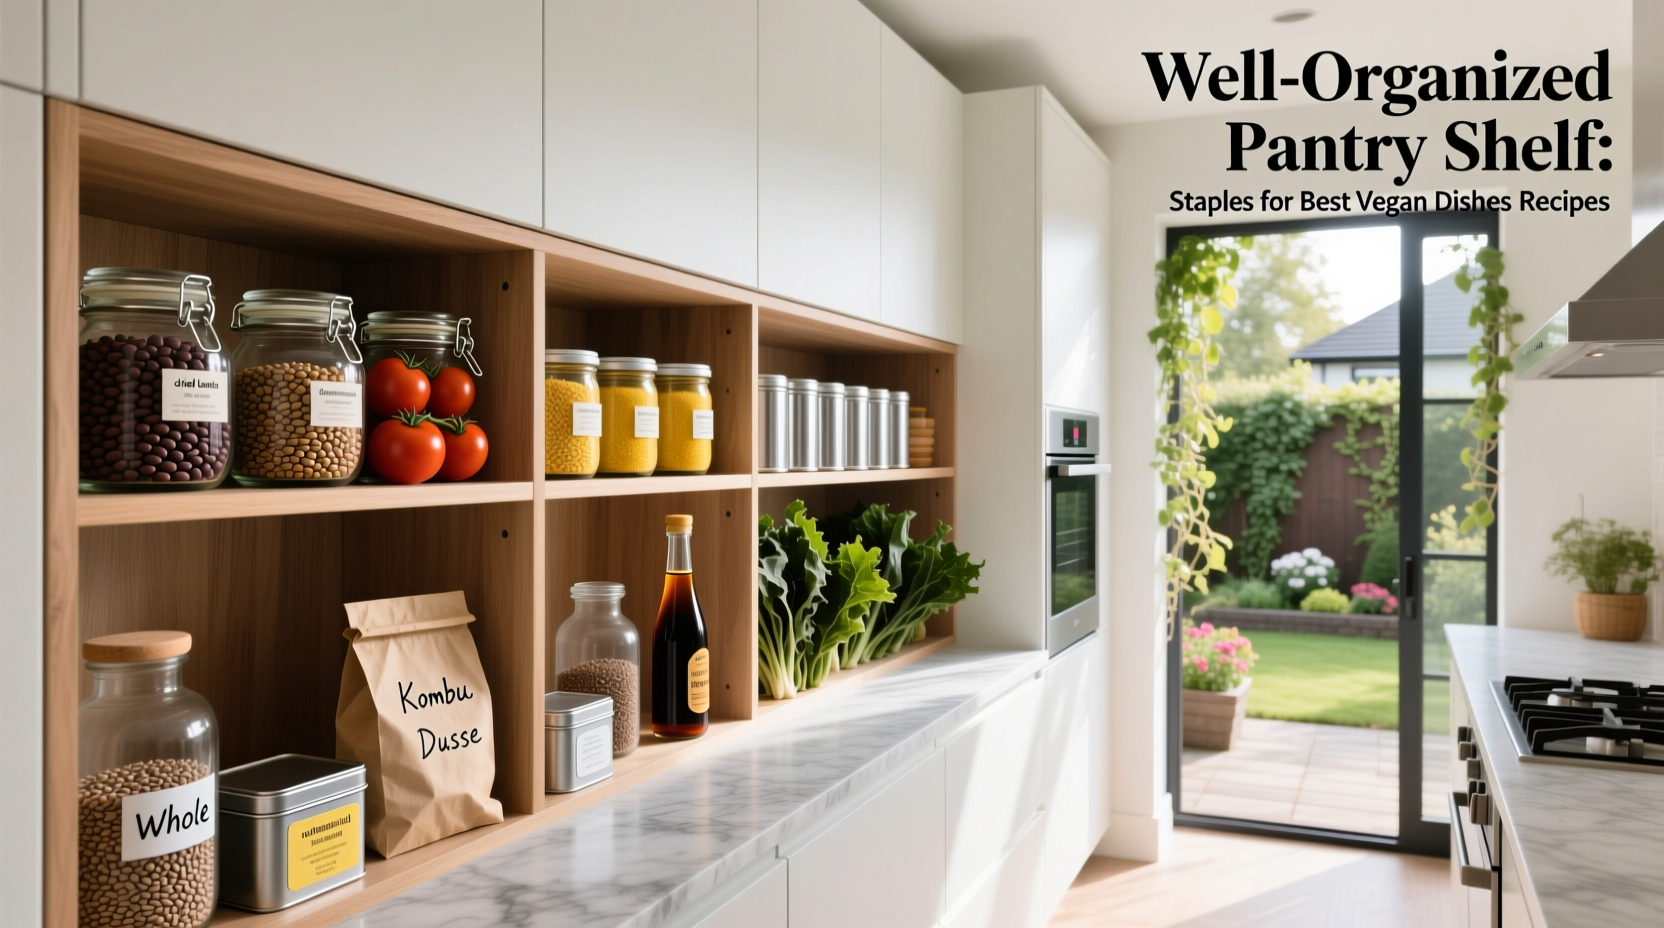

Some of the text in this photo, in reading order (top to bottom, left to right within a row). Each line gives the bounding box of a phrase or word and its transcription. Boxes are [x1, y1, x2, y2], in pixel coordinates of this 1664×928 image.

[398, 676, 474, 714] Kombu
[417, 728, 482, 760] Dusse
[135, 797, 210, 841] Whole
